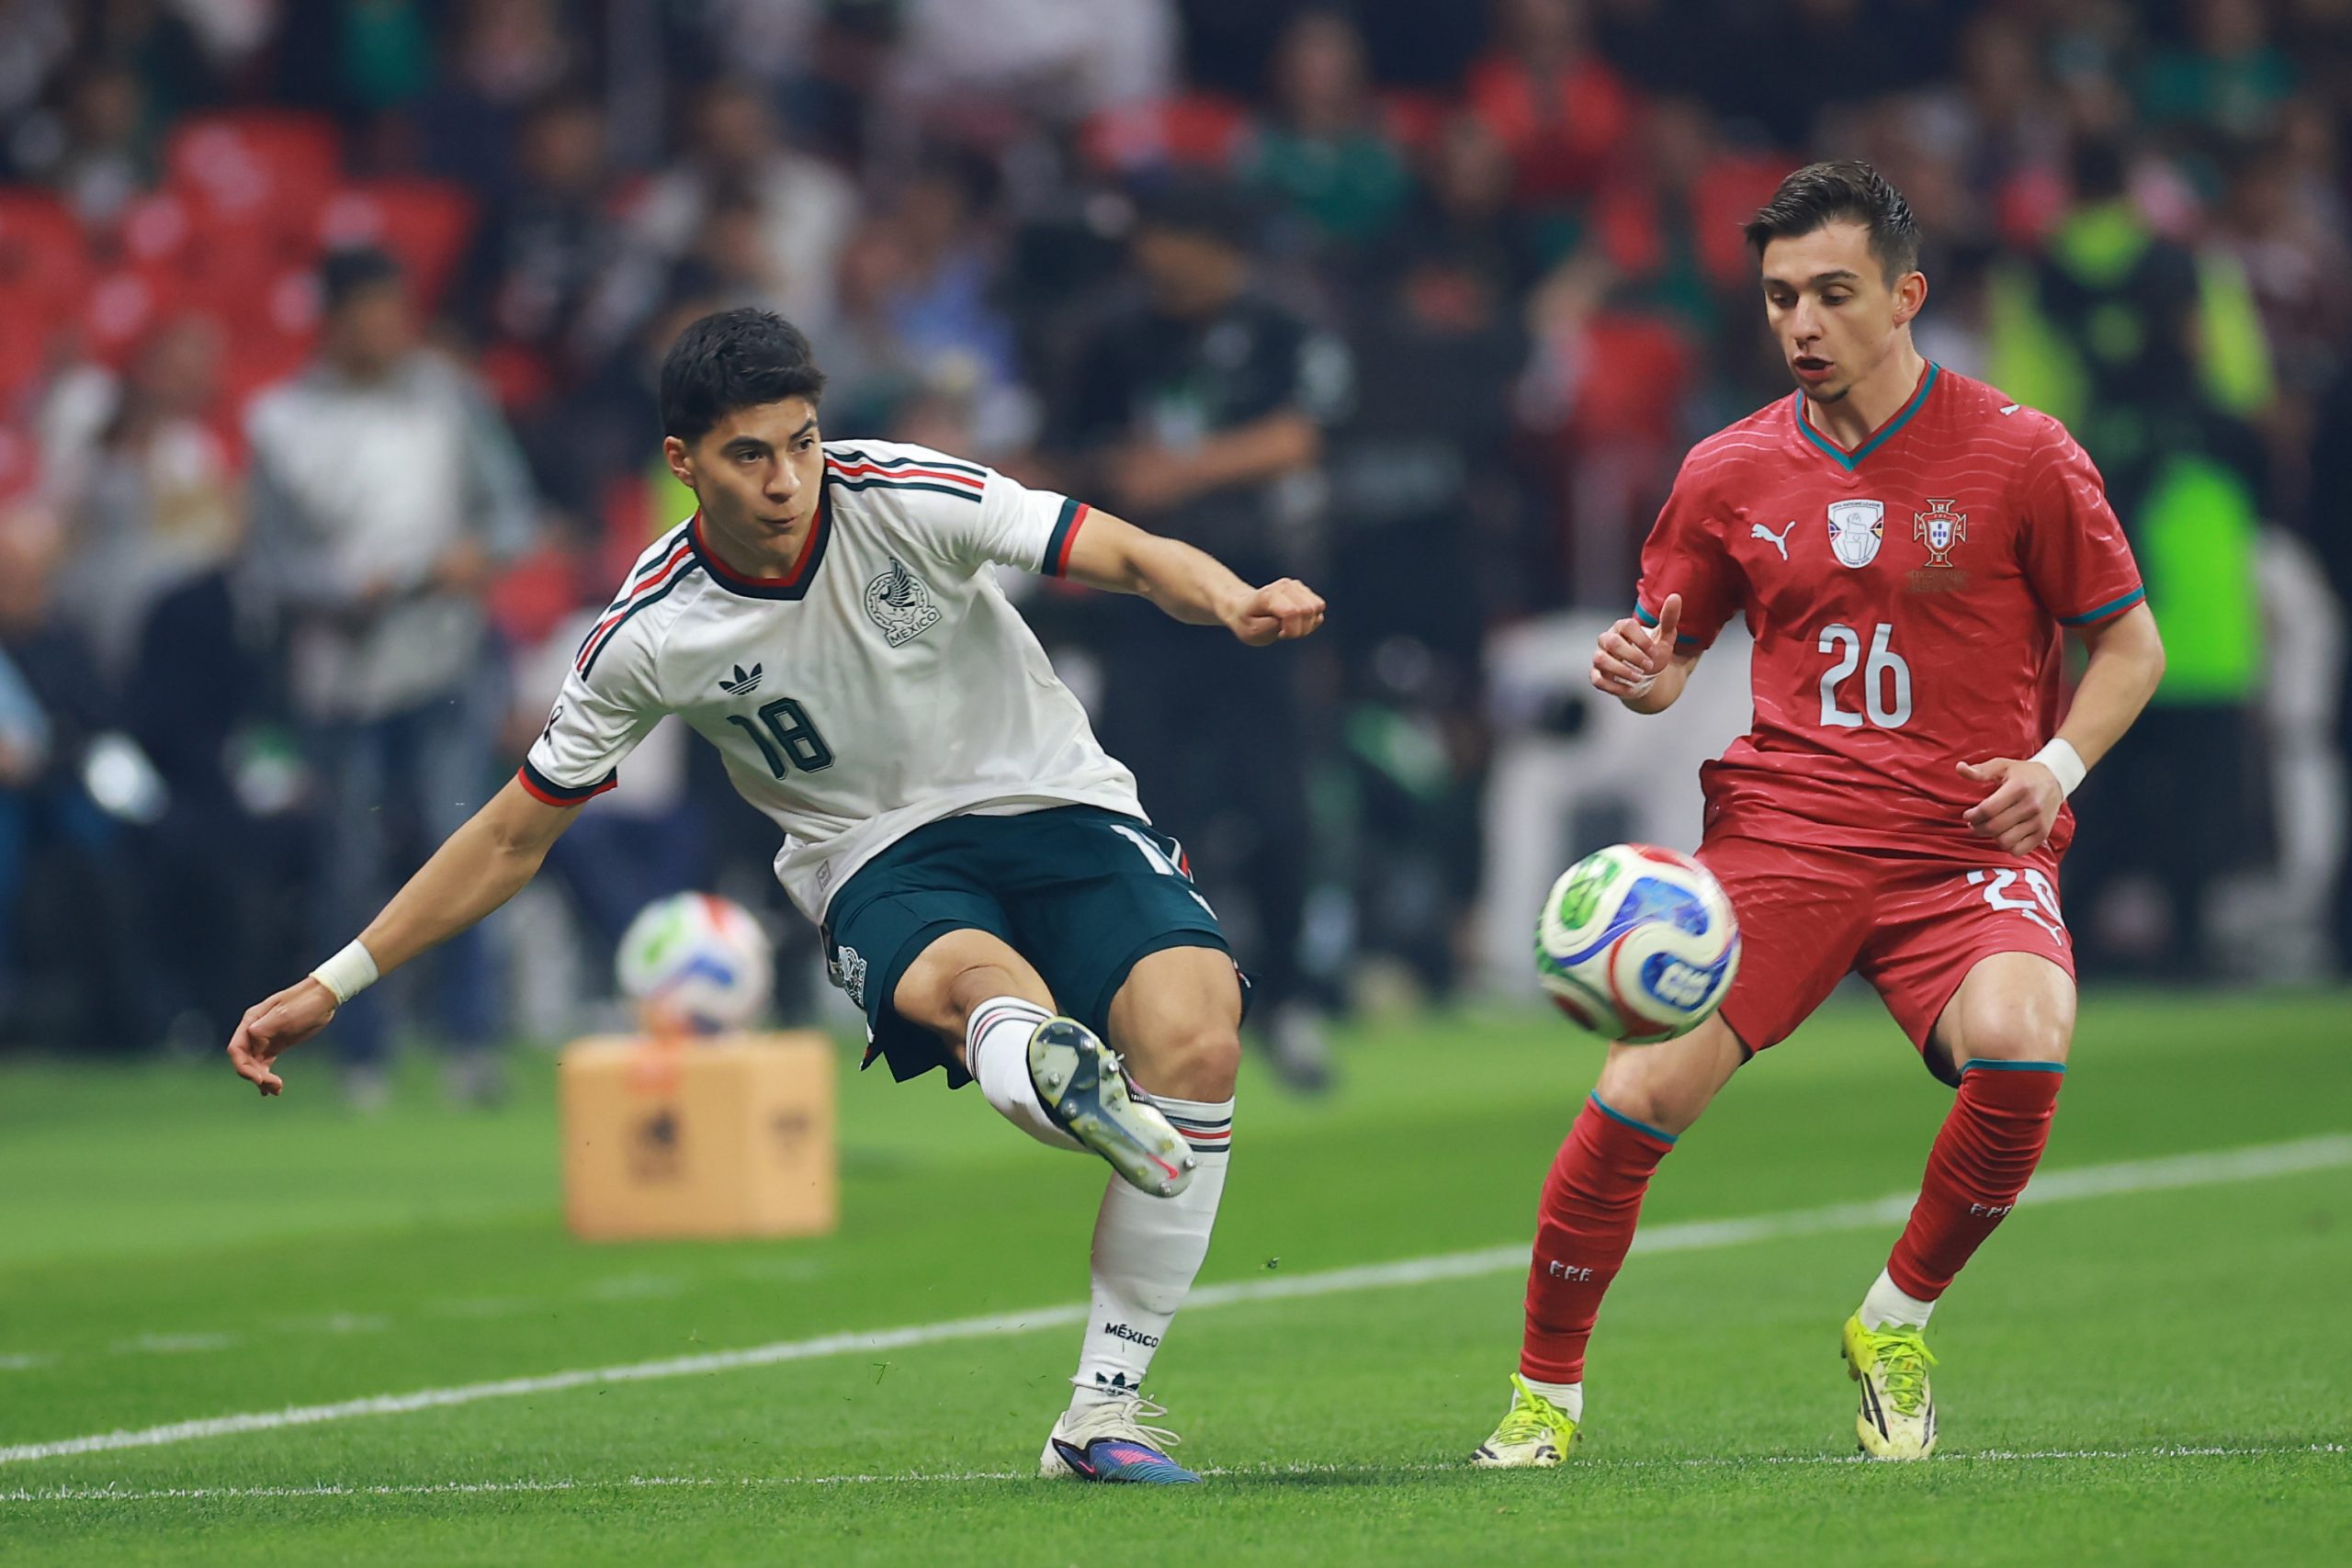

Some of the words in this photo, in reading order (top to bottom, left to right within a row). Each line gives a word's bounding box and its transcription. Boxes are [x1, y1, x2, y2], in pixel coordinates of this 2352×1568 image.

[1818, 623, 1913, 728] 26
[726, 697, 836, 781] 18
[1104, 1322, 1159, 1348] MÉXICO
